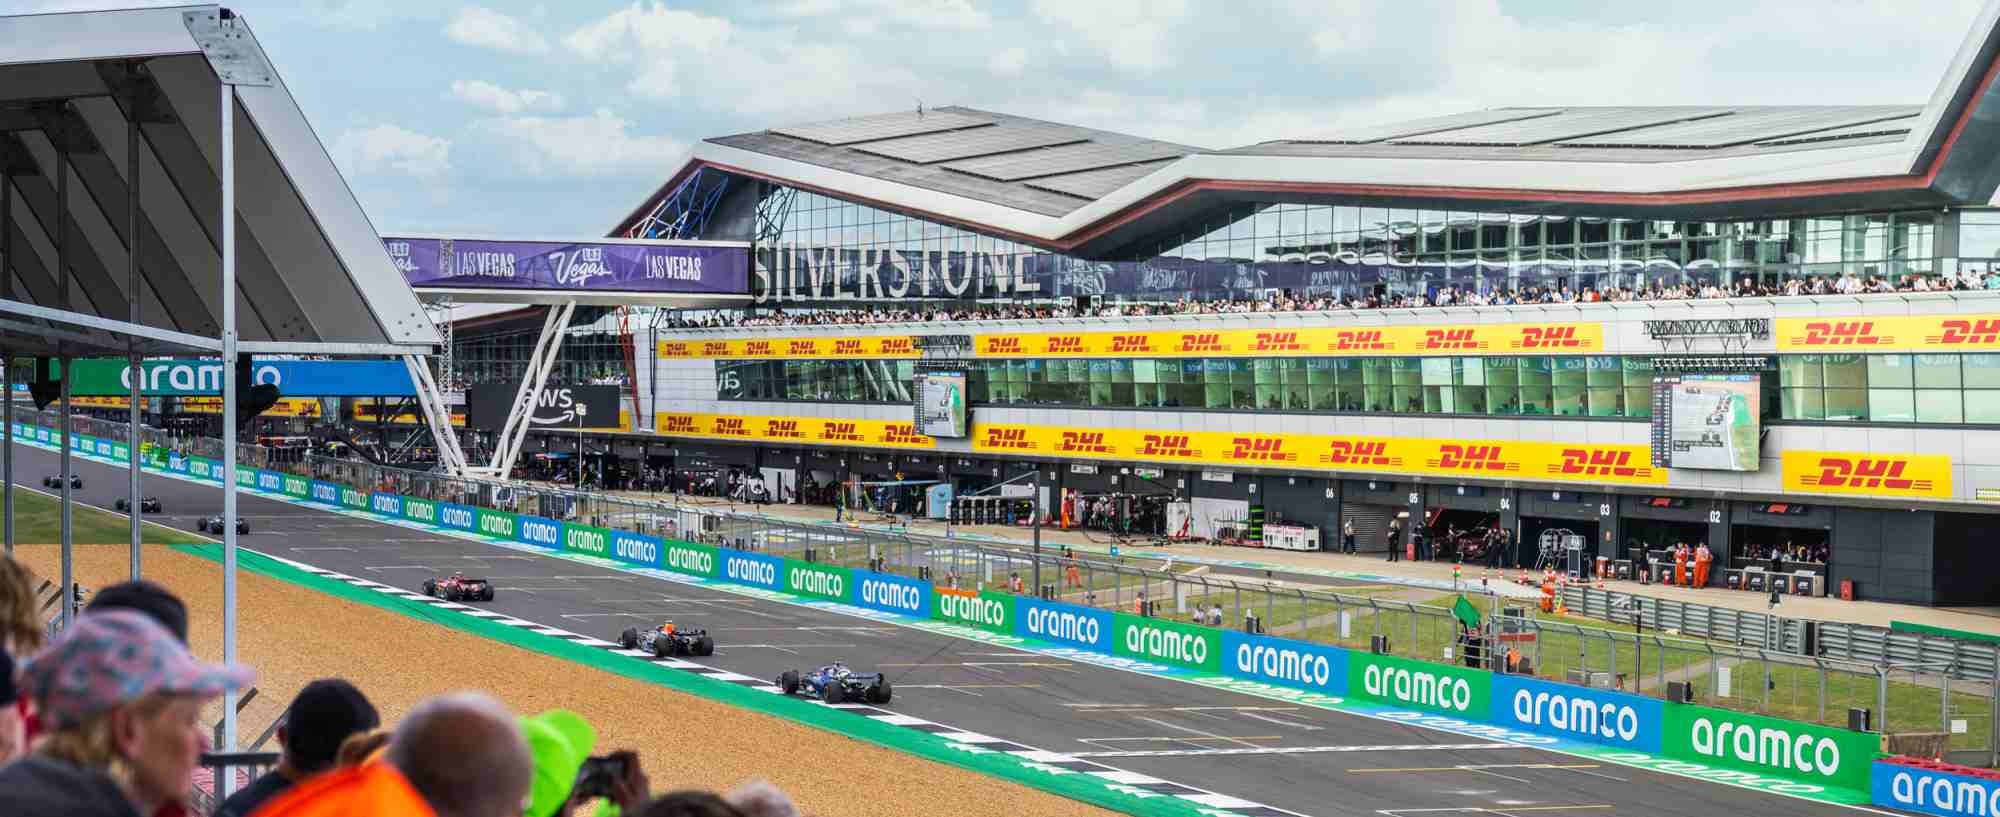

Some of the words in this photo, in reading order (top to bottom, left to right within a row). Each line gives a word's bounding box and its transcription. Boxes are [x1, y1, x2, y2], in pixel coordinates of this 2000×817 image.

[456, 252, 476, 276] LAS
[477, 253, 515, 277] VEGAS
[549, 248, 612, 287] Vegas
[646, 254, 663, 279] LAS
[664, 255, 702, 281] VEGAS
[755, 241, 1040, 304] SILVERSTONE
[1182, 334, 1223, 351] DHL
[1256, 333, 1299, 350] DHL
[1337, 331, 1385, 349] DHL
[1425, 330, 1478, 348] DHL
[1521, 327, 1580, 347] DHL
[1805, 322, 1880, 345] DHL
[1941, 319, 2000, 344] DH
[746, 342, 770, 354] DHL
[790, 341, 817, 354] DHL
[835, 340, 863, 354] DHL
[882, 339, 910, 353] DHL
[988, 337, 1021, 352] DHL
[1048, 336, 1083, 352] DHL
[1112, 335, 1150, 352] DHL
[121, 364, 281, 391] aramo
[667, 416, 695, 432] DHL
[715, 418, 746, 435] DHL
[768, 420, 800, 438] DHL
[824, 422, 859, 440] DHL
[987, 428, 1029, 449] DHL
[1062, 432, 1106, 452] DHL
[1143, 435, 1193, 457] DHL
[1232, 438, 1287, 461] DHL
[1330, 441, 1391, 466] DHL
[1438, 445, 1506, 471] DHL
[1560, 449, 1637, 477] DHL
[1817, 458, 1914, 490] DHL
[343, 489, 367, 506] aramco
[374, 495, 399, 514] aramco
[406, 502, 434, 521] aramco
[443, 507, 472, 527] aramco
[1710, 510, 1721, 523] 02
[481, 514, 512, 536] aramco
[523, 521, 557, 544] aramco
[568, 528, 603, 552] aramco
[616, 538, 656, 562] aramco
[668, 546, 712, 572] aramco
[728, 556, 774, 585] aramco
[791, 569, 842, 597] aramco
[863, 580, 919, 610] aramco
[941, 591, 1004, 626] aramco
[1028, 607, 1099, 644] aramco
[1127, 625, 1207, 663] aramco
[1237, 643, 1329, 685] aramco
[1365, 664, 1470, 711] aramco
[1514, 689, 1638, 742] aramco
[1691, 718, 1840, 776] aramco
